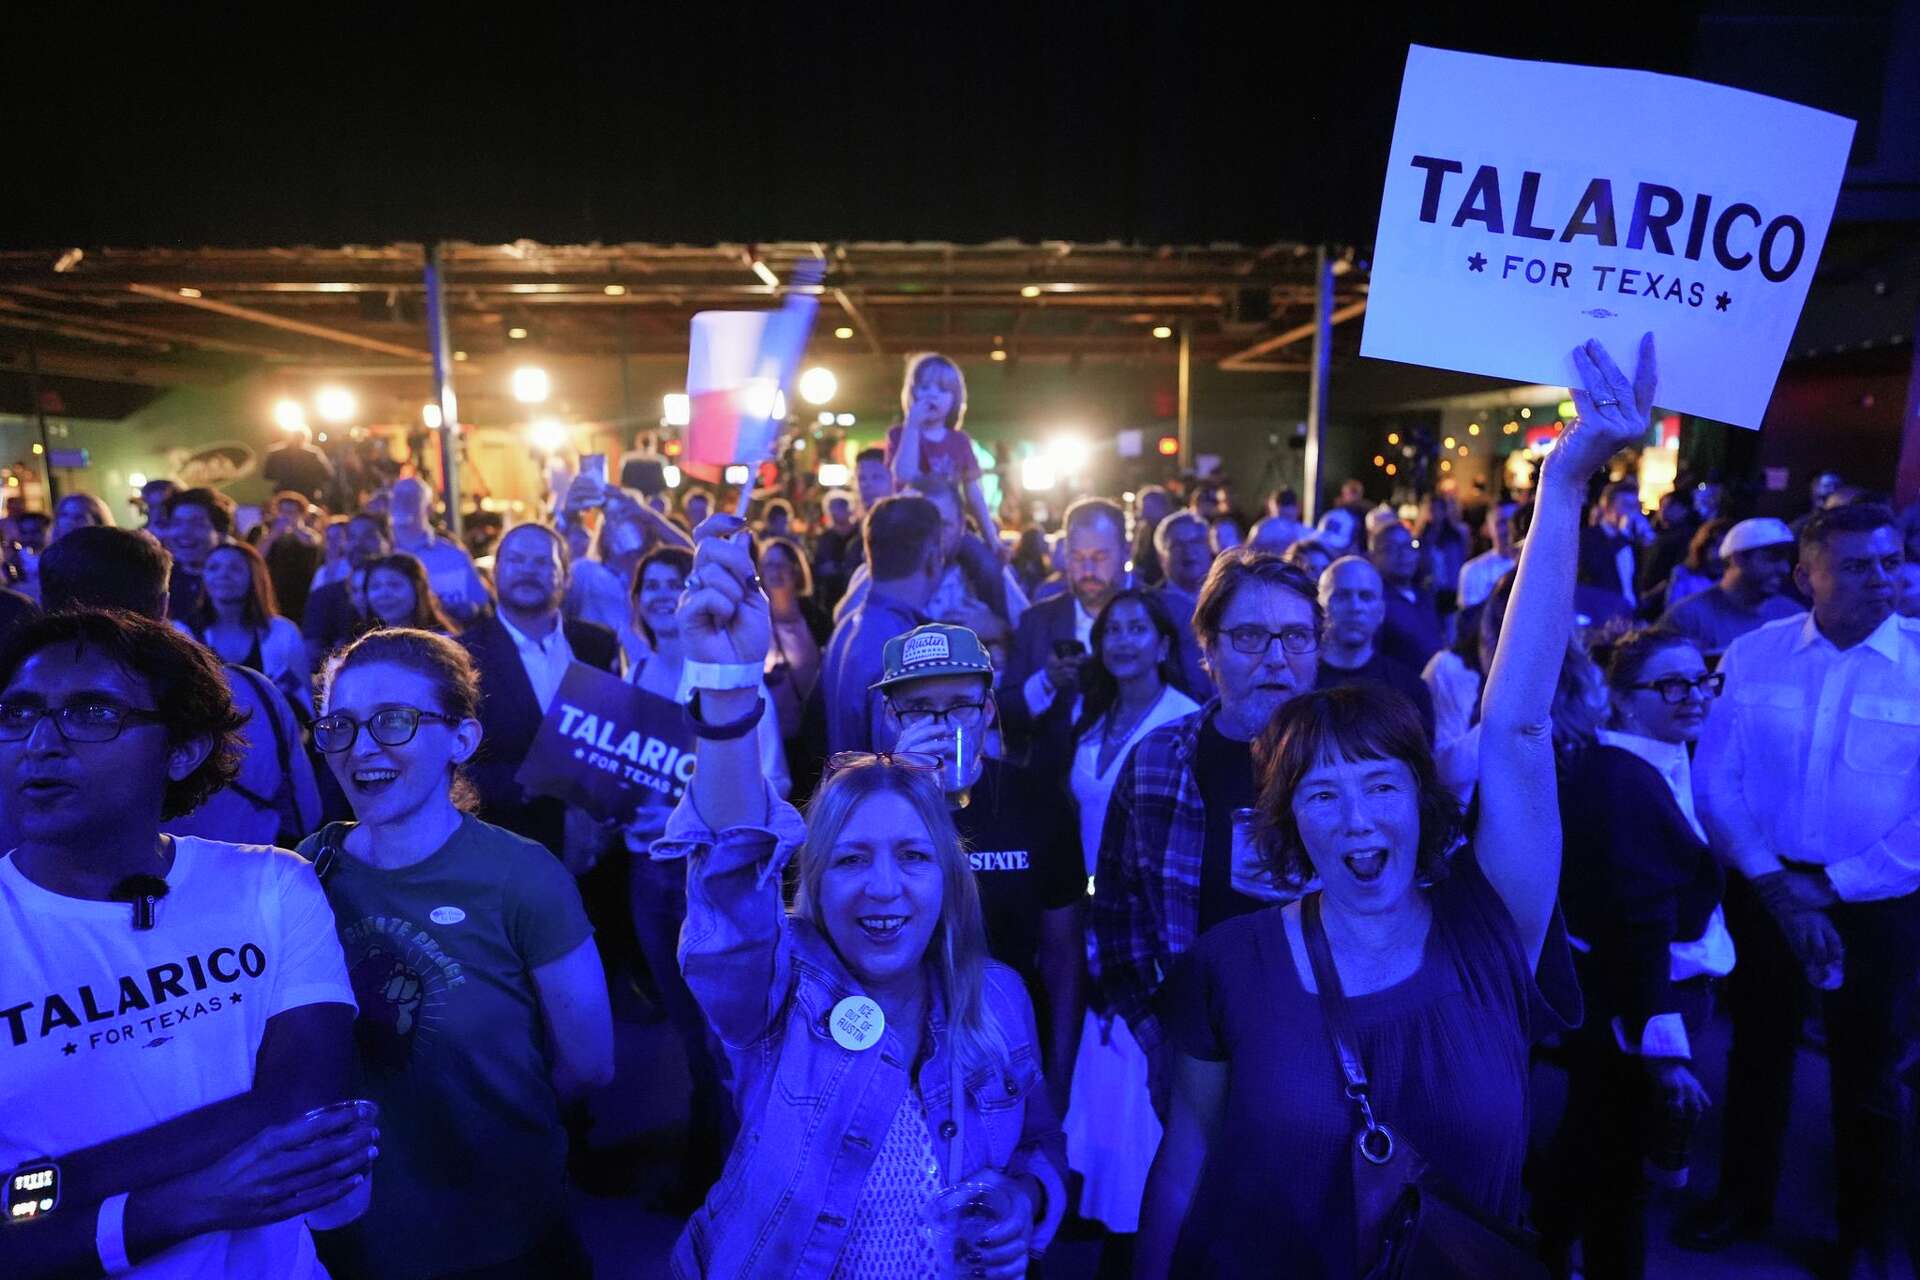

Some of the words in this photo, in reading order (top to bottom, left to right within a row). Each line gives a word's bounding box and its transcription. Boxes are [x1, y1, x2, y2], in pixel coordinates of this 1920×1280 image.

[1410, 155, 1806, 283] TALARICO
[1503, 255, 1572, 288] FOR
[1593, 266, 1705, 307] TEXAS
[907, 636, 945, 650] Austin
[558, 704, 698, 784] TALARIC
[588, 752, 619, 774] FOR
[624, 765, 671, 794] TEXAS
[969, 851, 1029, 871] STATE
[0, 942, 266, 1047] TALARICO
[858, 1003, 874, 1019] ICE
[90, 1025, 134, 1049] FOR
[141, 997, 222, 1033] TEXAS
[837, 1017, 865, 1042] AUSTIN
[845, 1008, 861, 1022] OUT
[860, 1021, 873, 1031] OF
